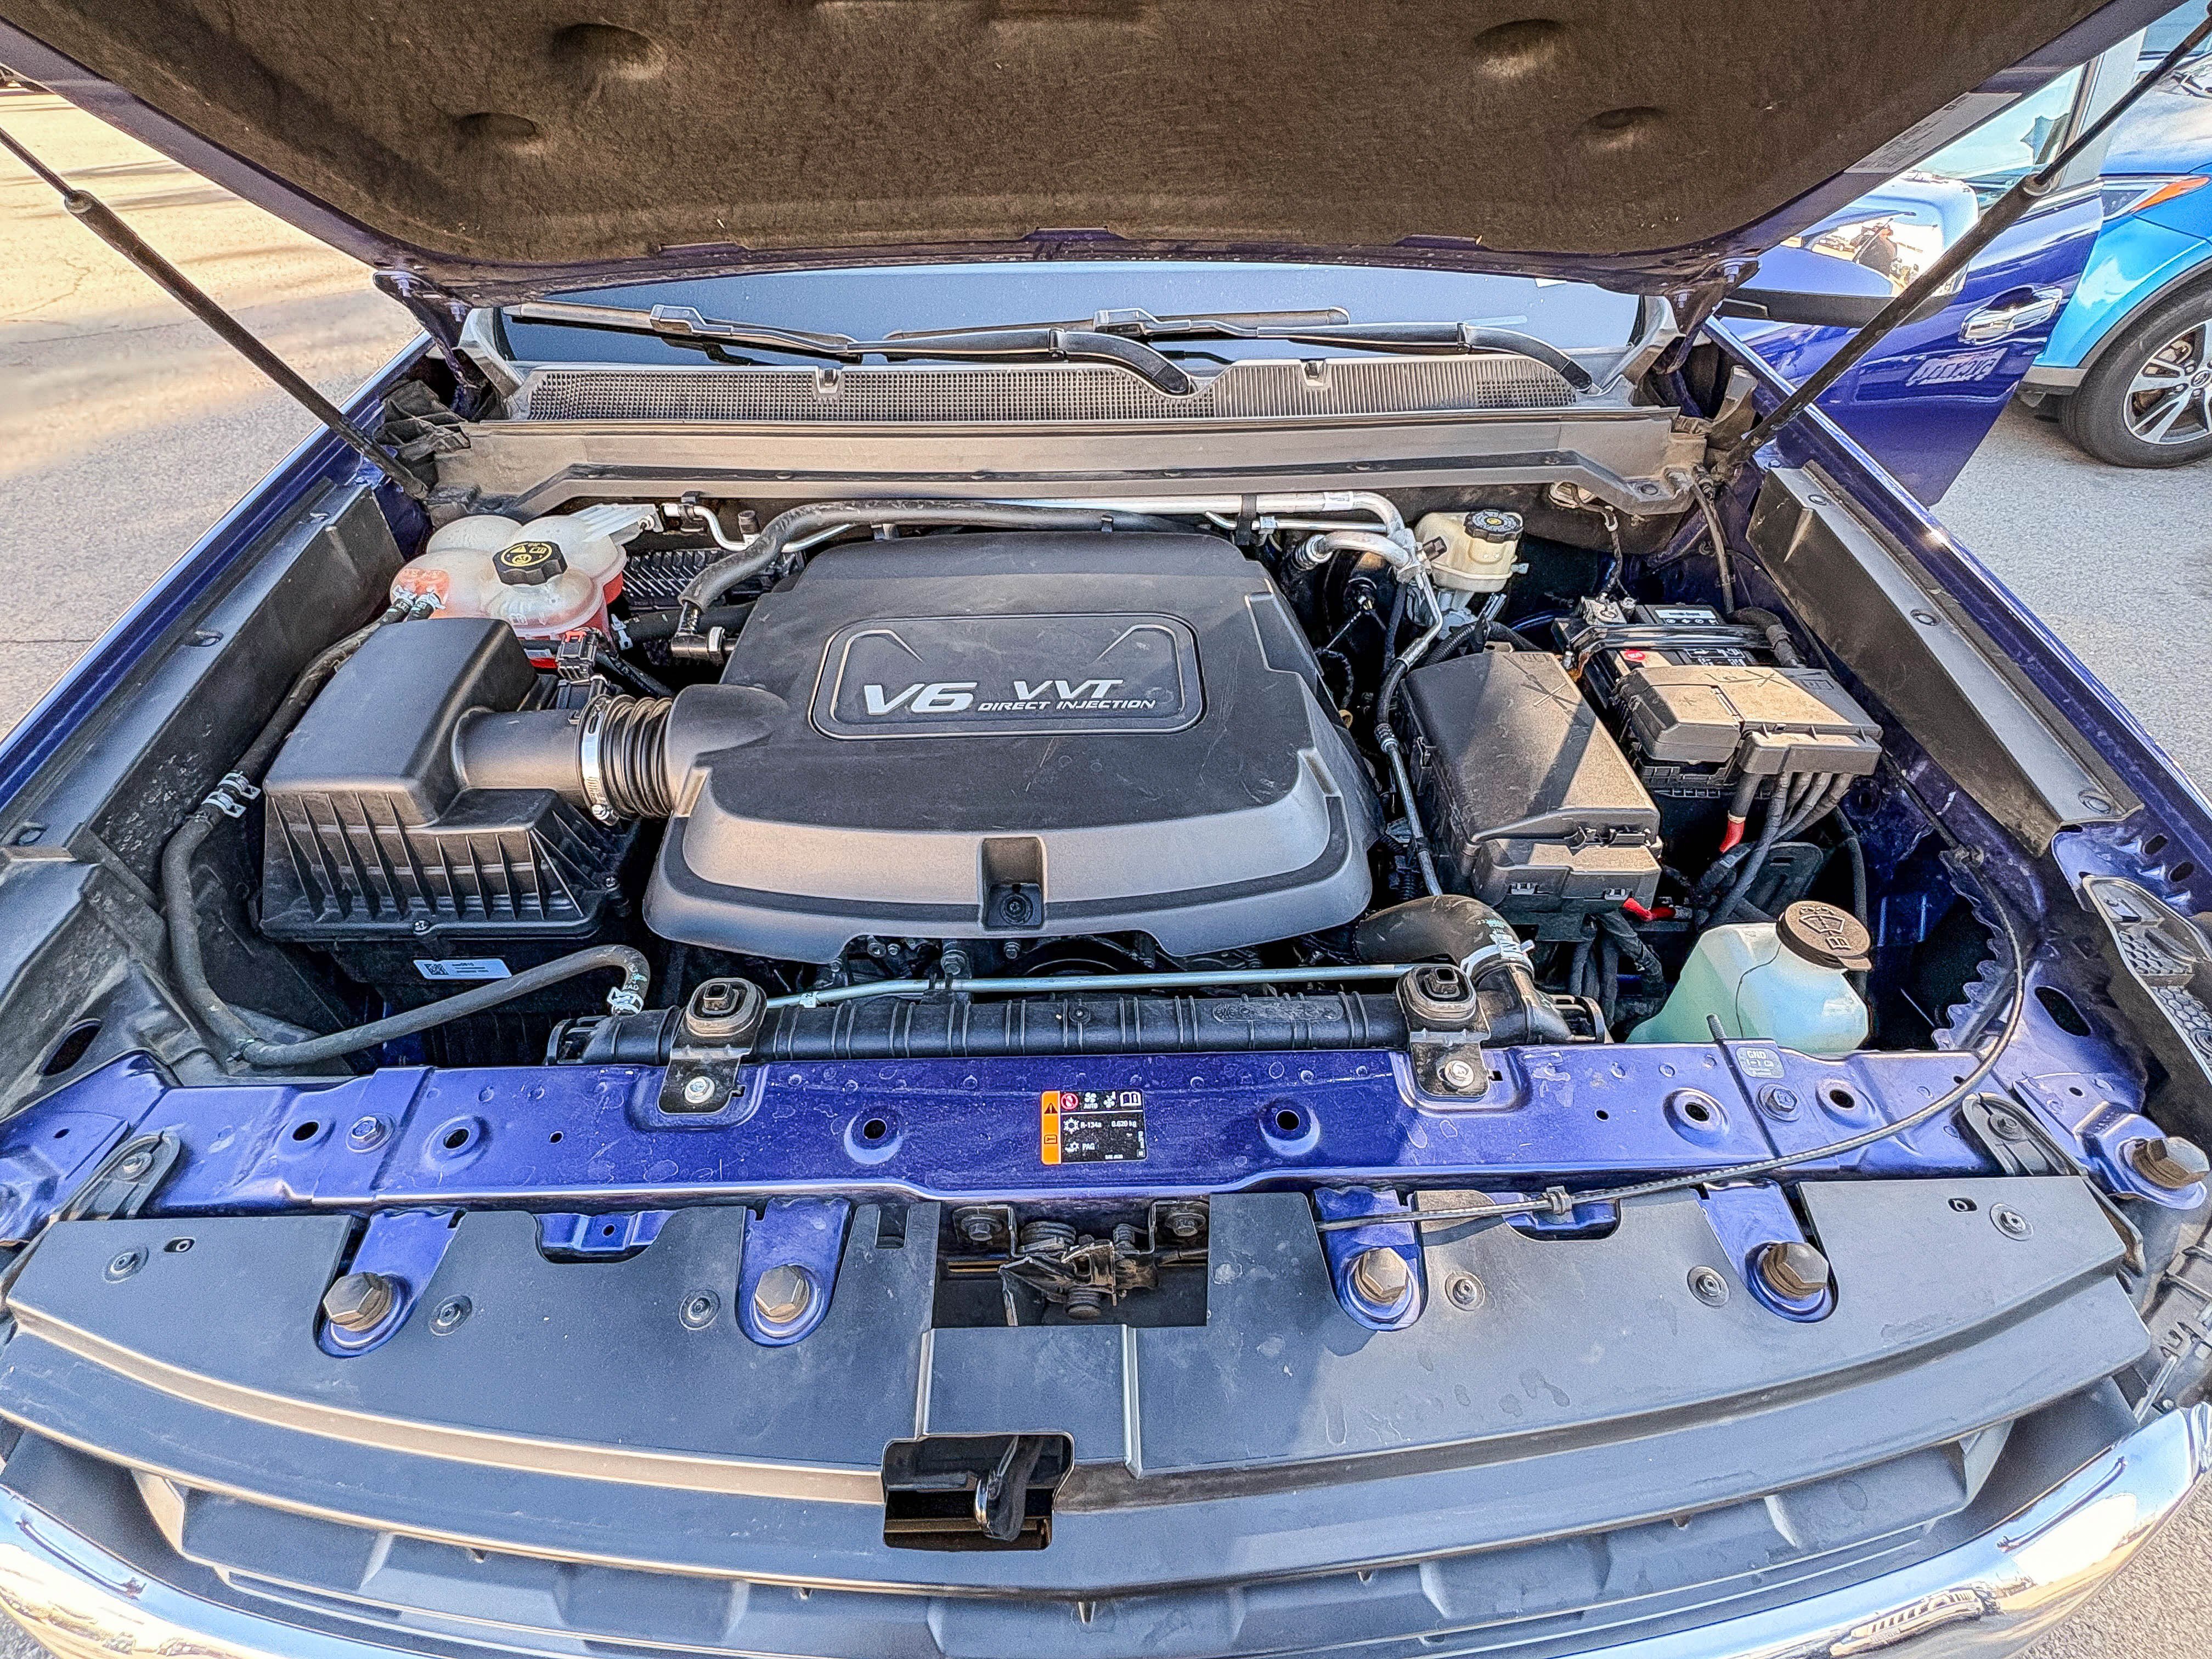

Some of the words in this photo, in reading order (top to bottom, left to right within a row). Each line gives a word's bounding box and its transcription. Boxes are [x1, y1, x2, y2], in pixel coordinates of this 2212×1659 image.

[1013, 679, 1124, 701] VVT
[864, 681, 978, 715] V6
[978, 701, 1051, 712] DIRECT
[1056, 699, 1156, 710] INJECTION
[1746, 1050, 1767, 1059] GND
[1082, 1143, 1096, 1151] PAG
